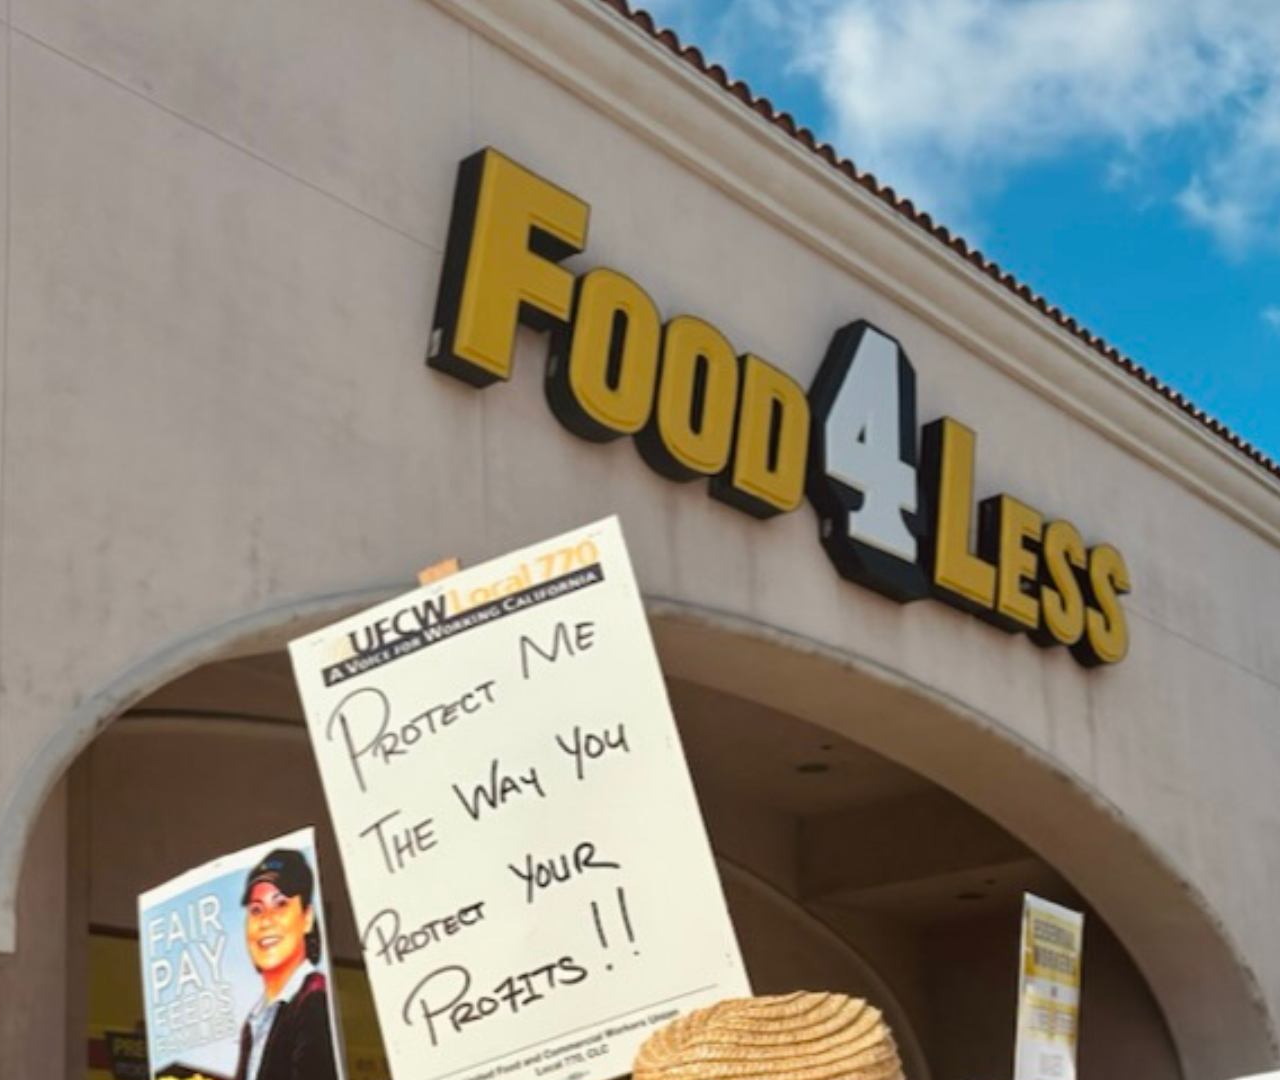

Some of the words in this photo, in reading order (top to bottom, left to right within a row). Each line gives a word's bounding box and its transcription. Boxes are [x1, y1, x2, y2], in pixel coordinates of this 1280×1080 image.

[430, 146, 812, 519] FOOD
[815, 321, 922, 592] 4
[924, 416, 1131, 667] LESS
[328, 666, 345, 684] A
[345, 650, 392, 677] VOICE
[394, 637, 421, 660] FOR
[422, 607, 500, 643] WORKING
[501, 571, 599, 612] CALIFORNIA
[348, 594, 447, 655] UFCW
[448, 563, 533, 614] Local
[535, 539, 598, 579] 770
[326, 680, 495, 792] PROTECT
[519, 621, 596, 679] ME
[359, 809, 438, 873] THE
[452, 759, 546, 822] WAY
[555, 723, 630, 780] YOU
[149, 895, 223, 956] FAIR
[360, 901, 485, 965] PROTECT
[508, 842, 620, 902] YOUR
[151, 935, 226, 1005] PAY
